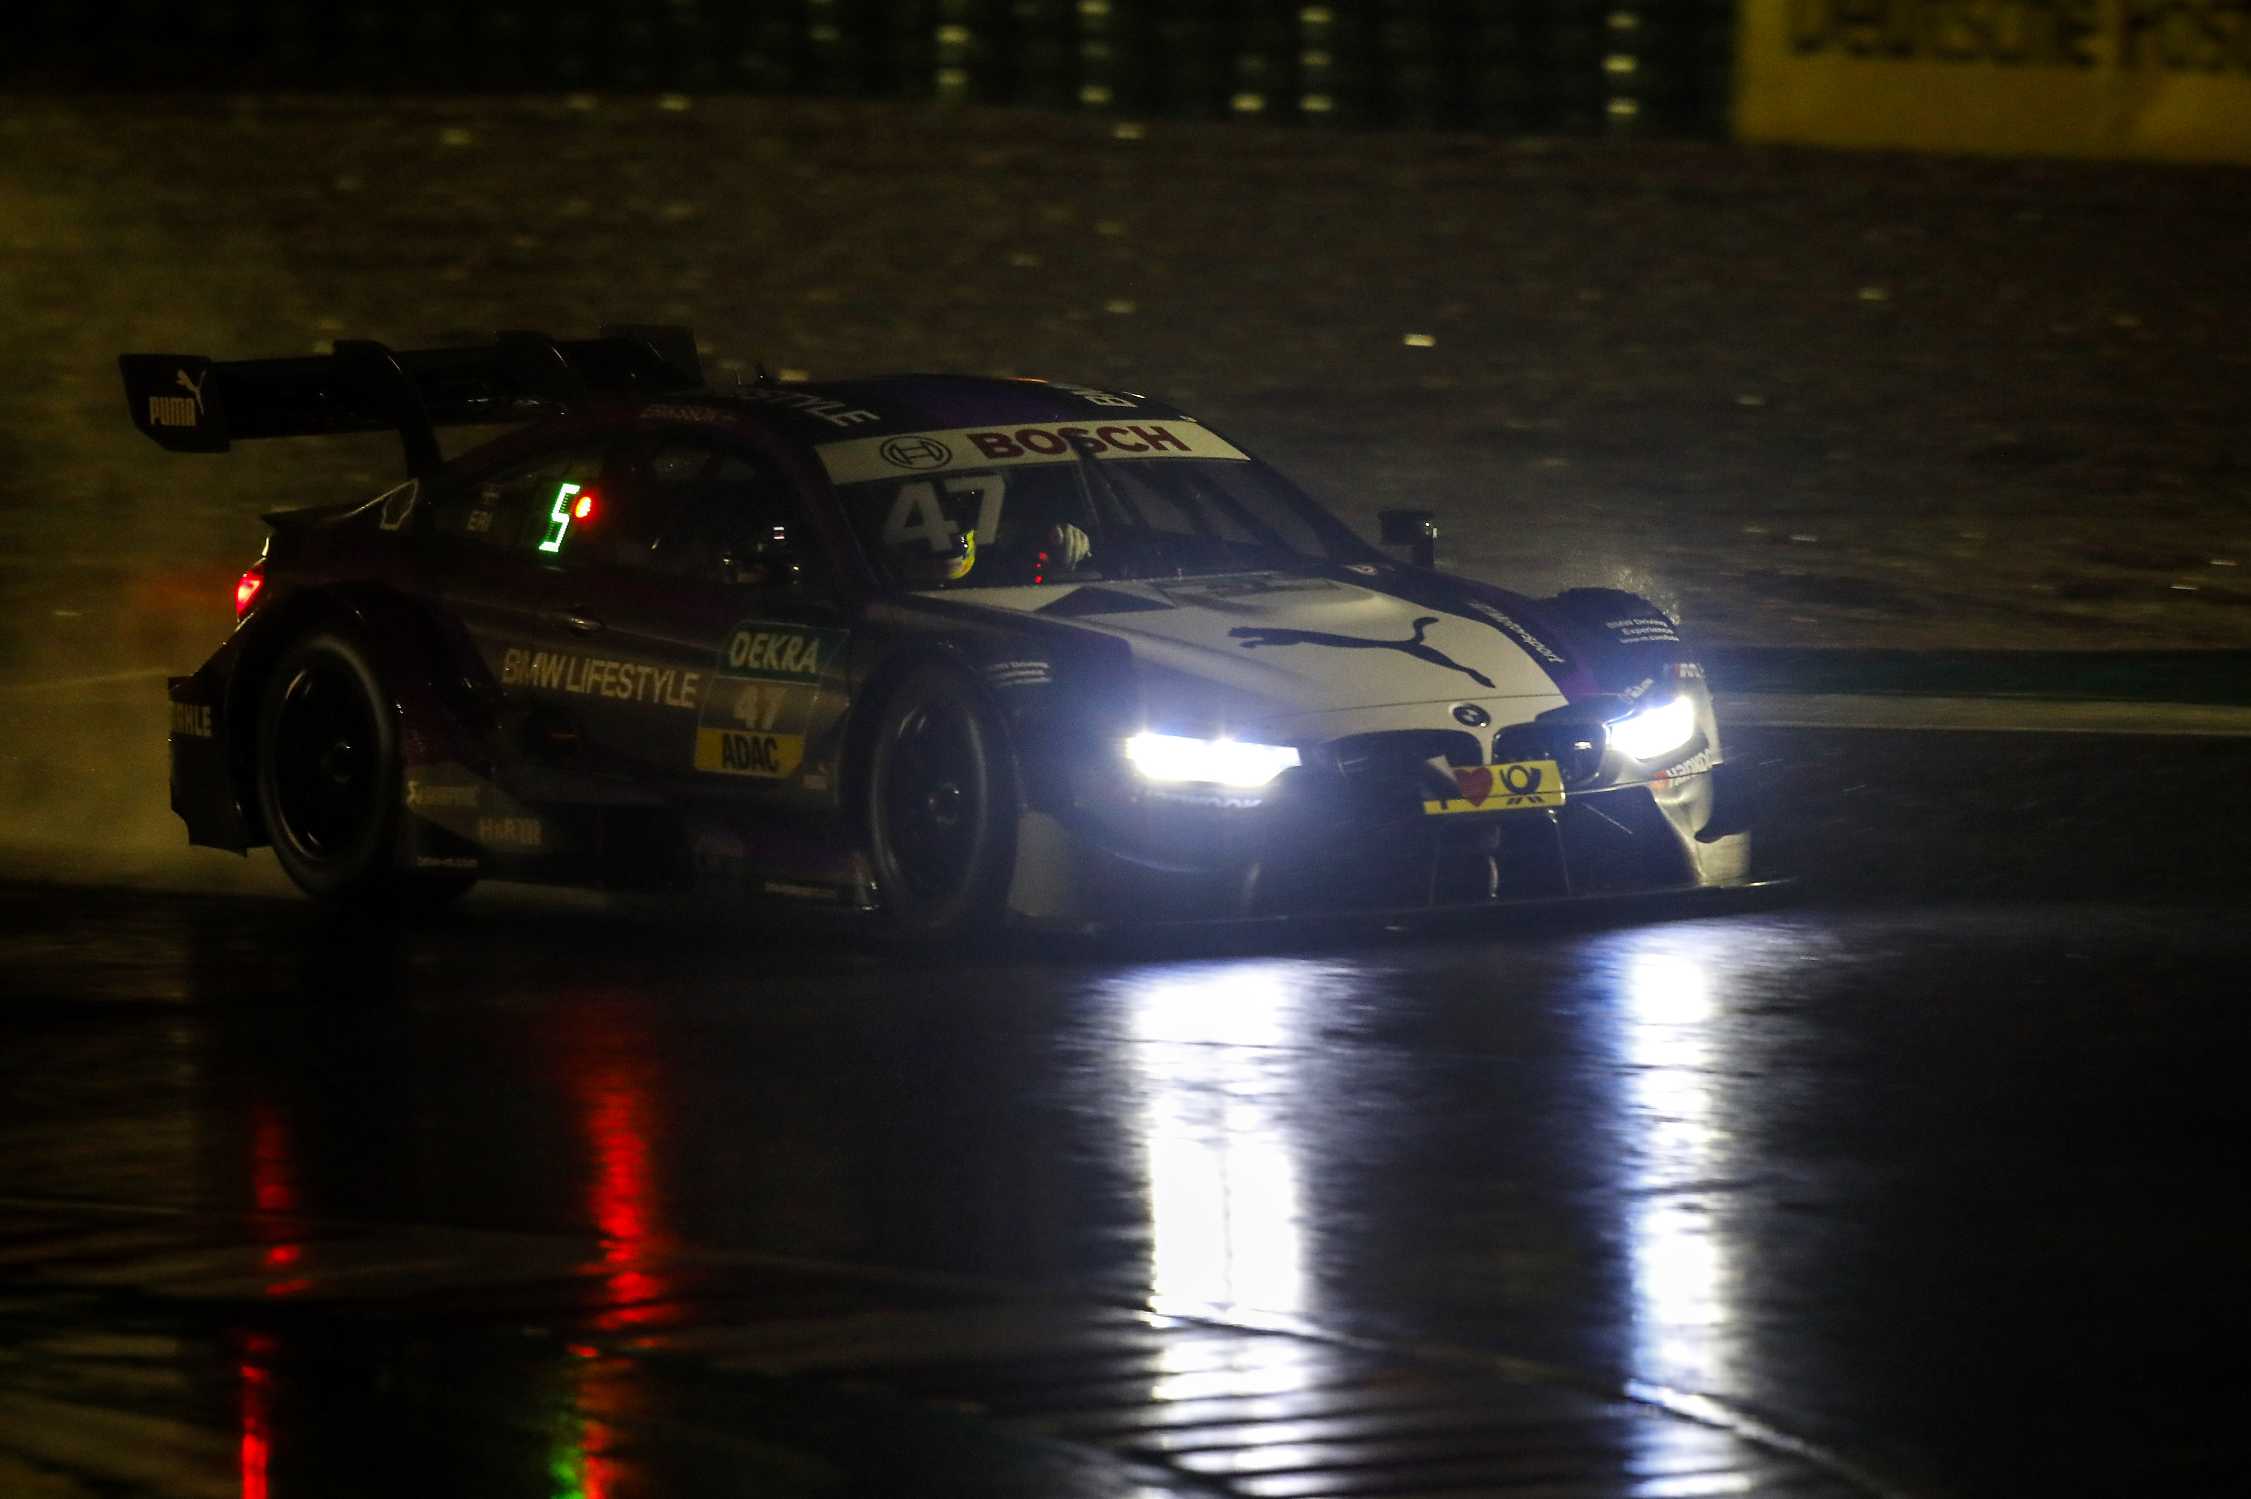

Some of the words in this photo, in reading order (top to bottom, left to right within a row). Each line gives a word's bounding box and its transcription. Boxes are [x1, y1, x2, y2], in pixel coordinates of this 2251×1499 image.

[148, 396, 197, 427] PUMA
[965, 424, 1192, 461] BOSCH
[881, 472, 1008, 552] 47
[728, 631, 821, 674] DEKRA
[501, 647, 568, 689] BMW
[564, 656, 702, 709] LIFESTYLE
[732, 684, 789, 732] 47
[723, 733, 779, 774] ADAC
